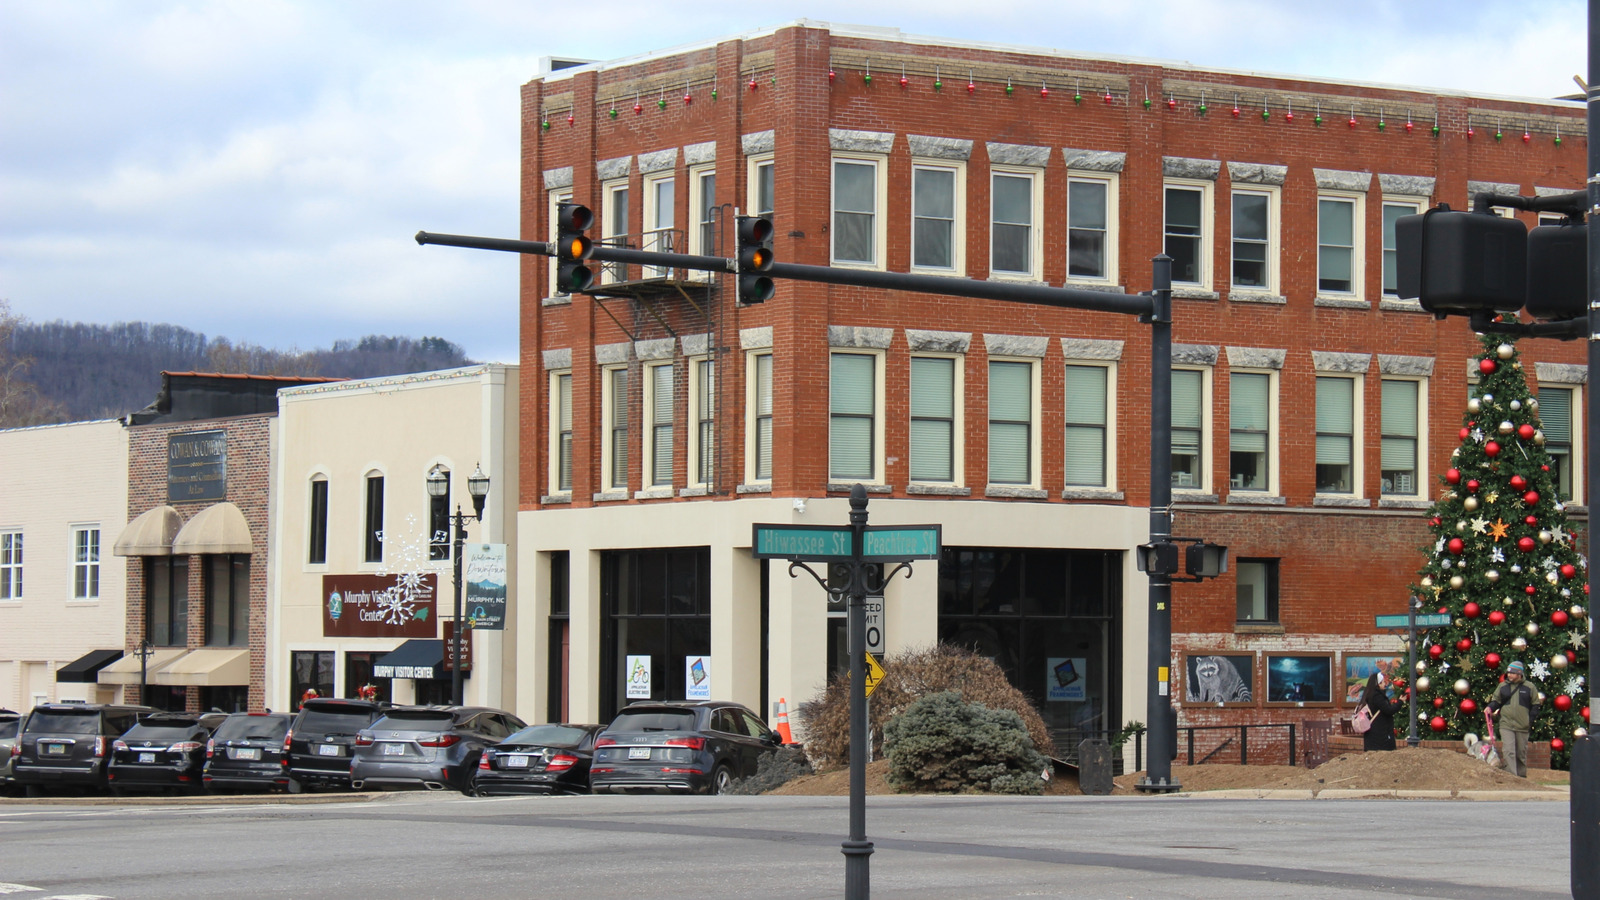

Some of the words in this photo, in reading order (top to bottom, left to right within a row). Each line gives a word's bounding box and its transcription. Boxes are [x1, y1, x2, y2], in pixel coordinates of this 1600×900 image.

[170, 441, 193, 459] COWAN
[194, 440, 200, 457] &
[764, 529, 825, 554] Hiwassee
[832, 531, 845, 555] St
[867, 531, 918, 554] Peachtree
[922, 531, 934, 554] St
[467, 563, 506, 576] Downtown
[344, 590, 371, 607] Murphy
[865, 603, 882, 612] EED
[360, 609, 383, 622] Center
[865, 615, 878, 623] MIT
[1415, 615, 1428, 626] alley
[866, 626, 880, 647] 0
[374, 665, 394, 678] MURPHY
[394, 665, 414, 678] VISITOR
[414, 666, 434, 679] CENTER
